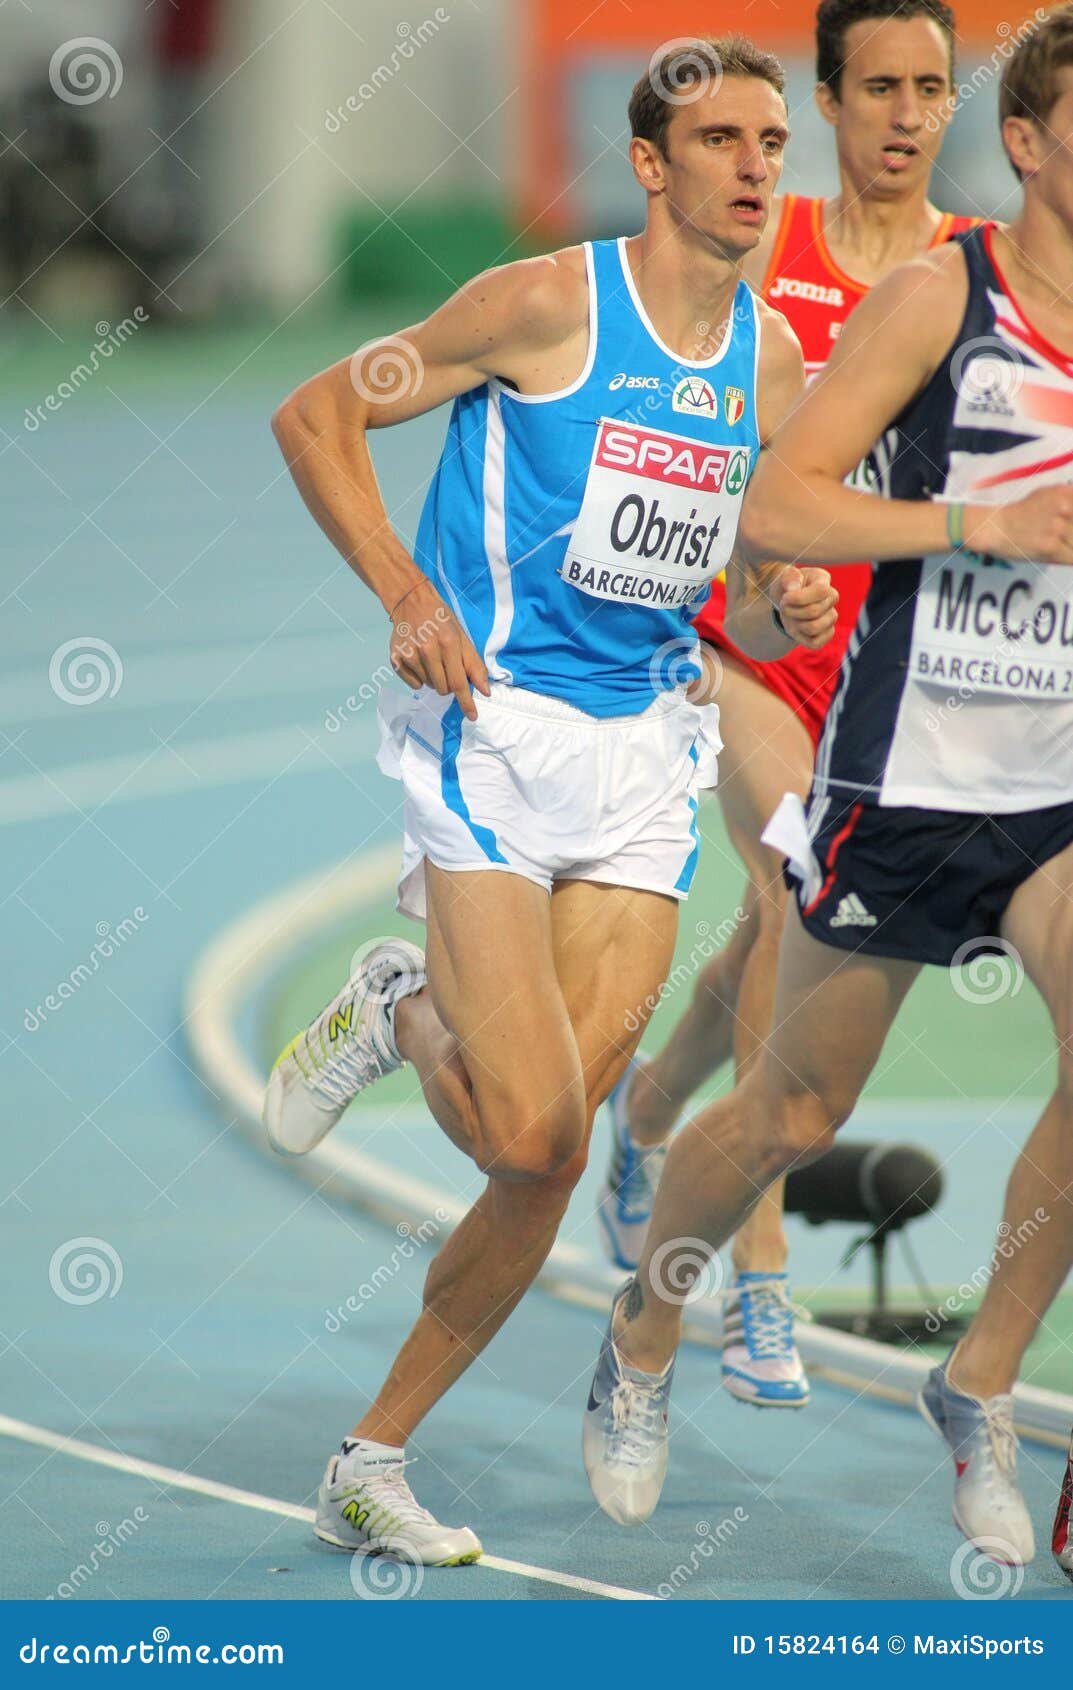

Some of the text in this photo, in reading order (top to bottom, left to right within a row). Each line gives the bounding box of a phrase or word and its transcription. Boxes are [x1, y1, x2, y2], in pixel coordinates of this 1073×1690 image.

[602, 431, 726, 487] SPAR
[610, 493, 721, 569] Obrist
[568, 560, 678, 604] BARCELONA
[918, 651, 1055, 691] BARCELONA
